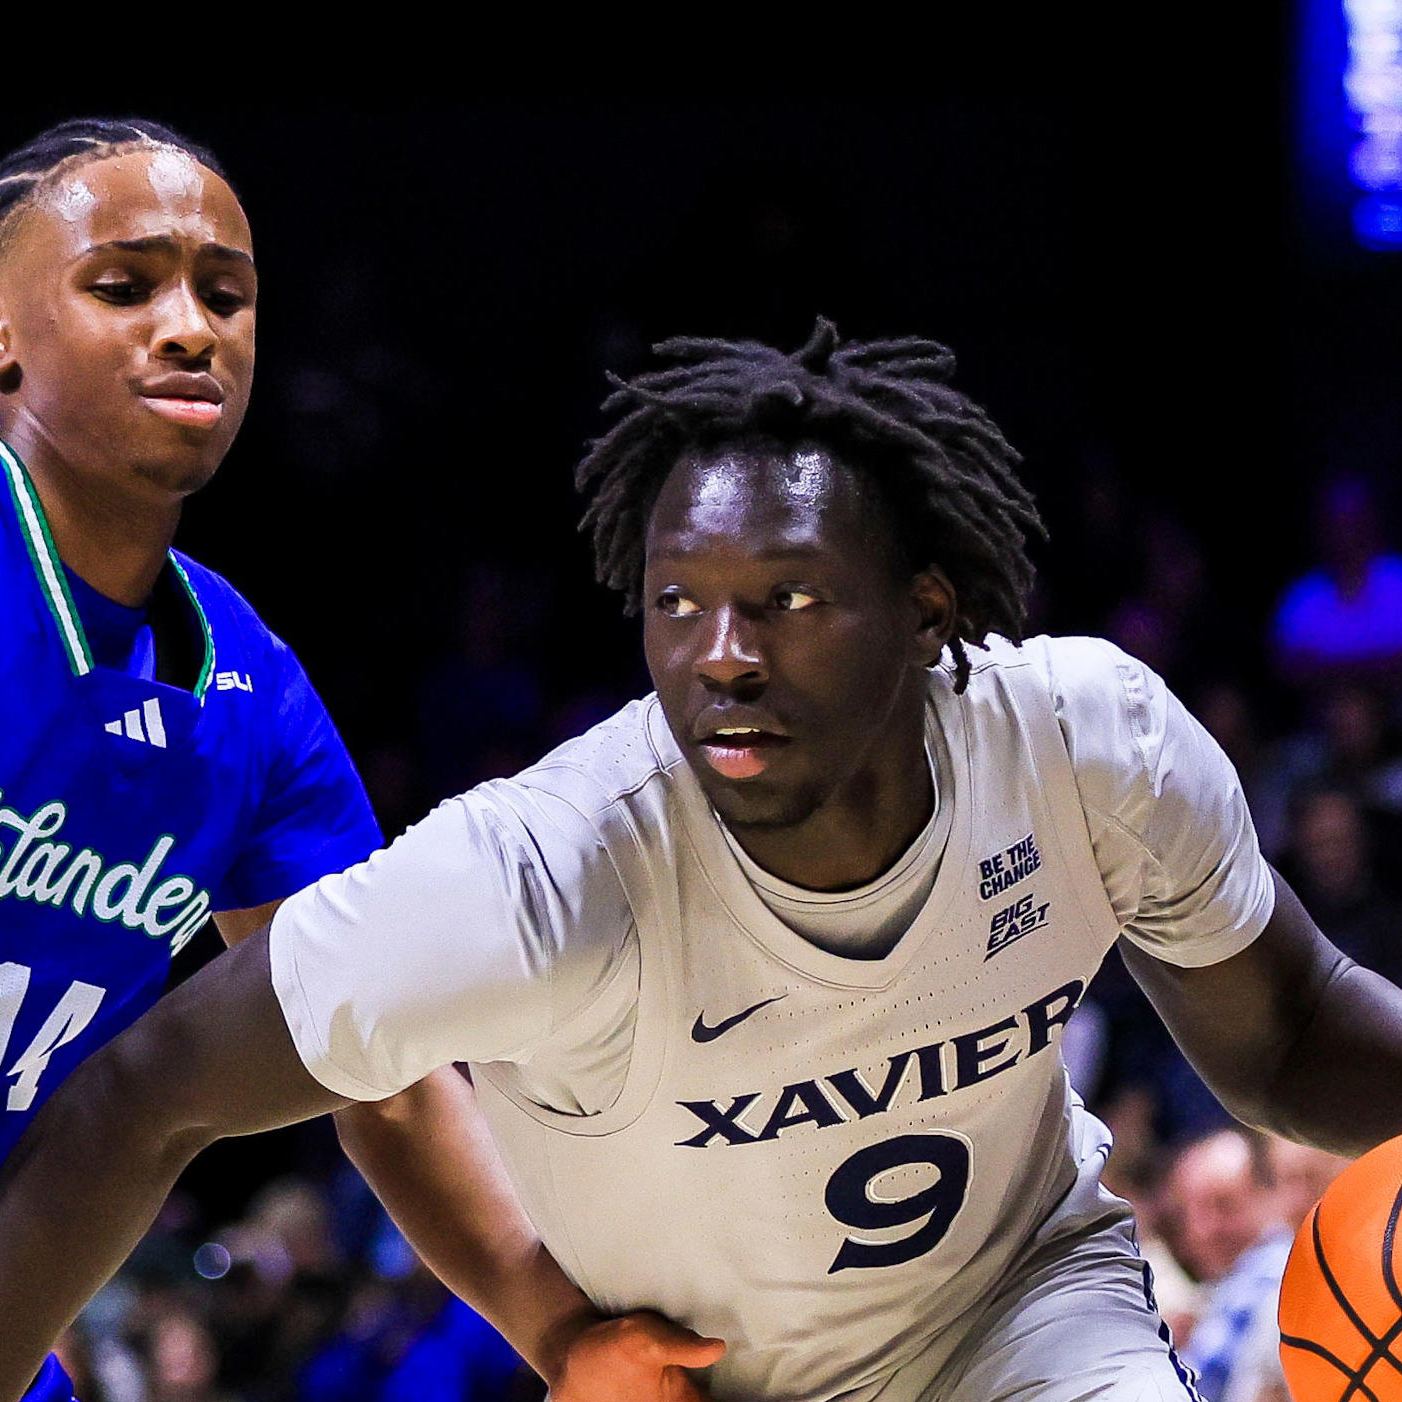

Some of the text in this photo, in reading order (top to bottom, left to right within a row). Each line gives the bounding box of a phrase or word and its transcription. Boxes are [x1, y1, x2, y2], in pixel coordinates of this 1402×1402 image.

[979, 833, 1035, 880] BE THE
[980, 850, 1041, 900] CHANGE
[986, 902, 1050, 951] EAST
[989, 893, 1034, 935] BIG
[674, 977, 1089, 1148] XAVIER
[825, 1128, 974, 1274] 9
